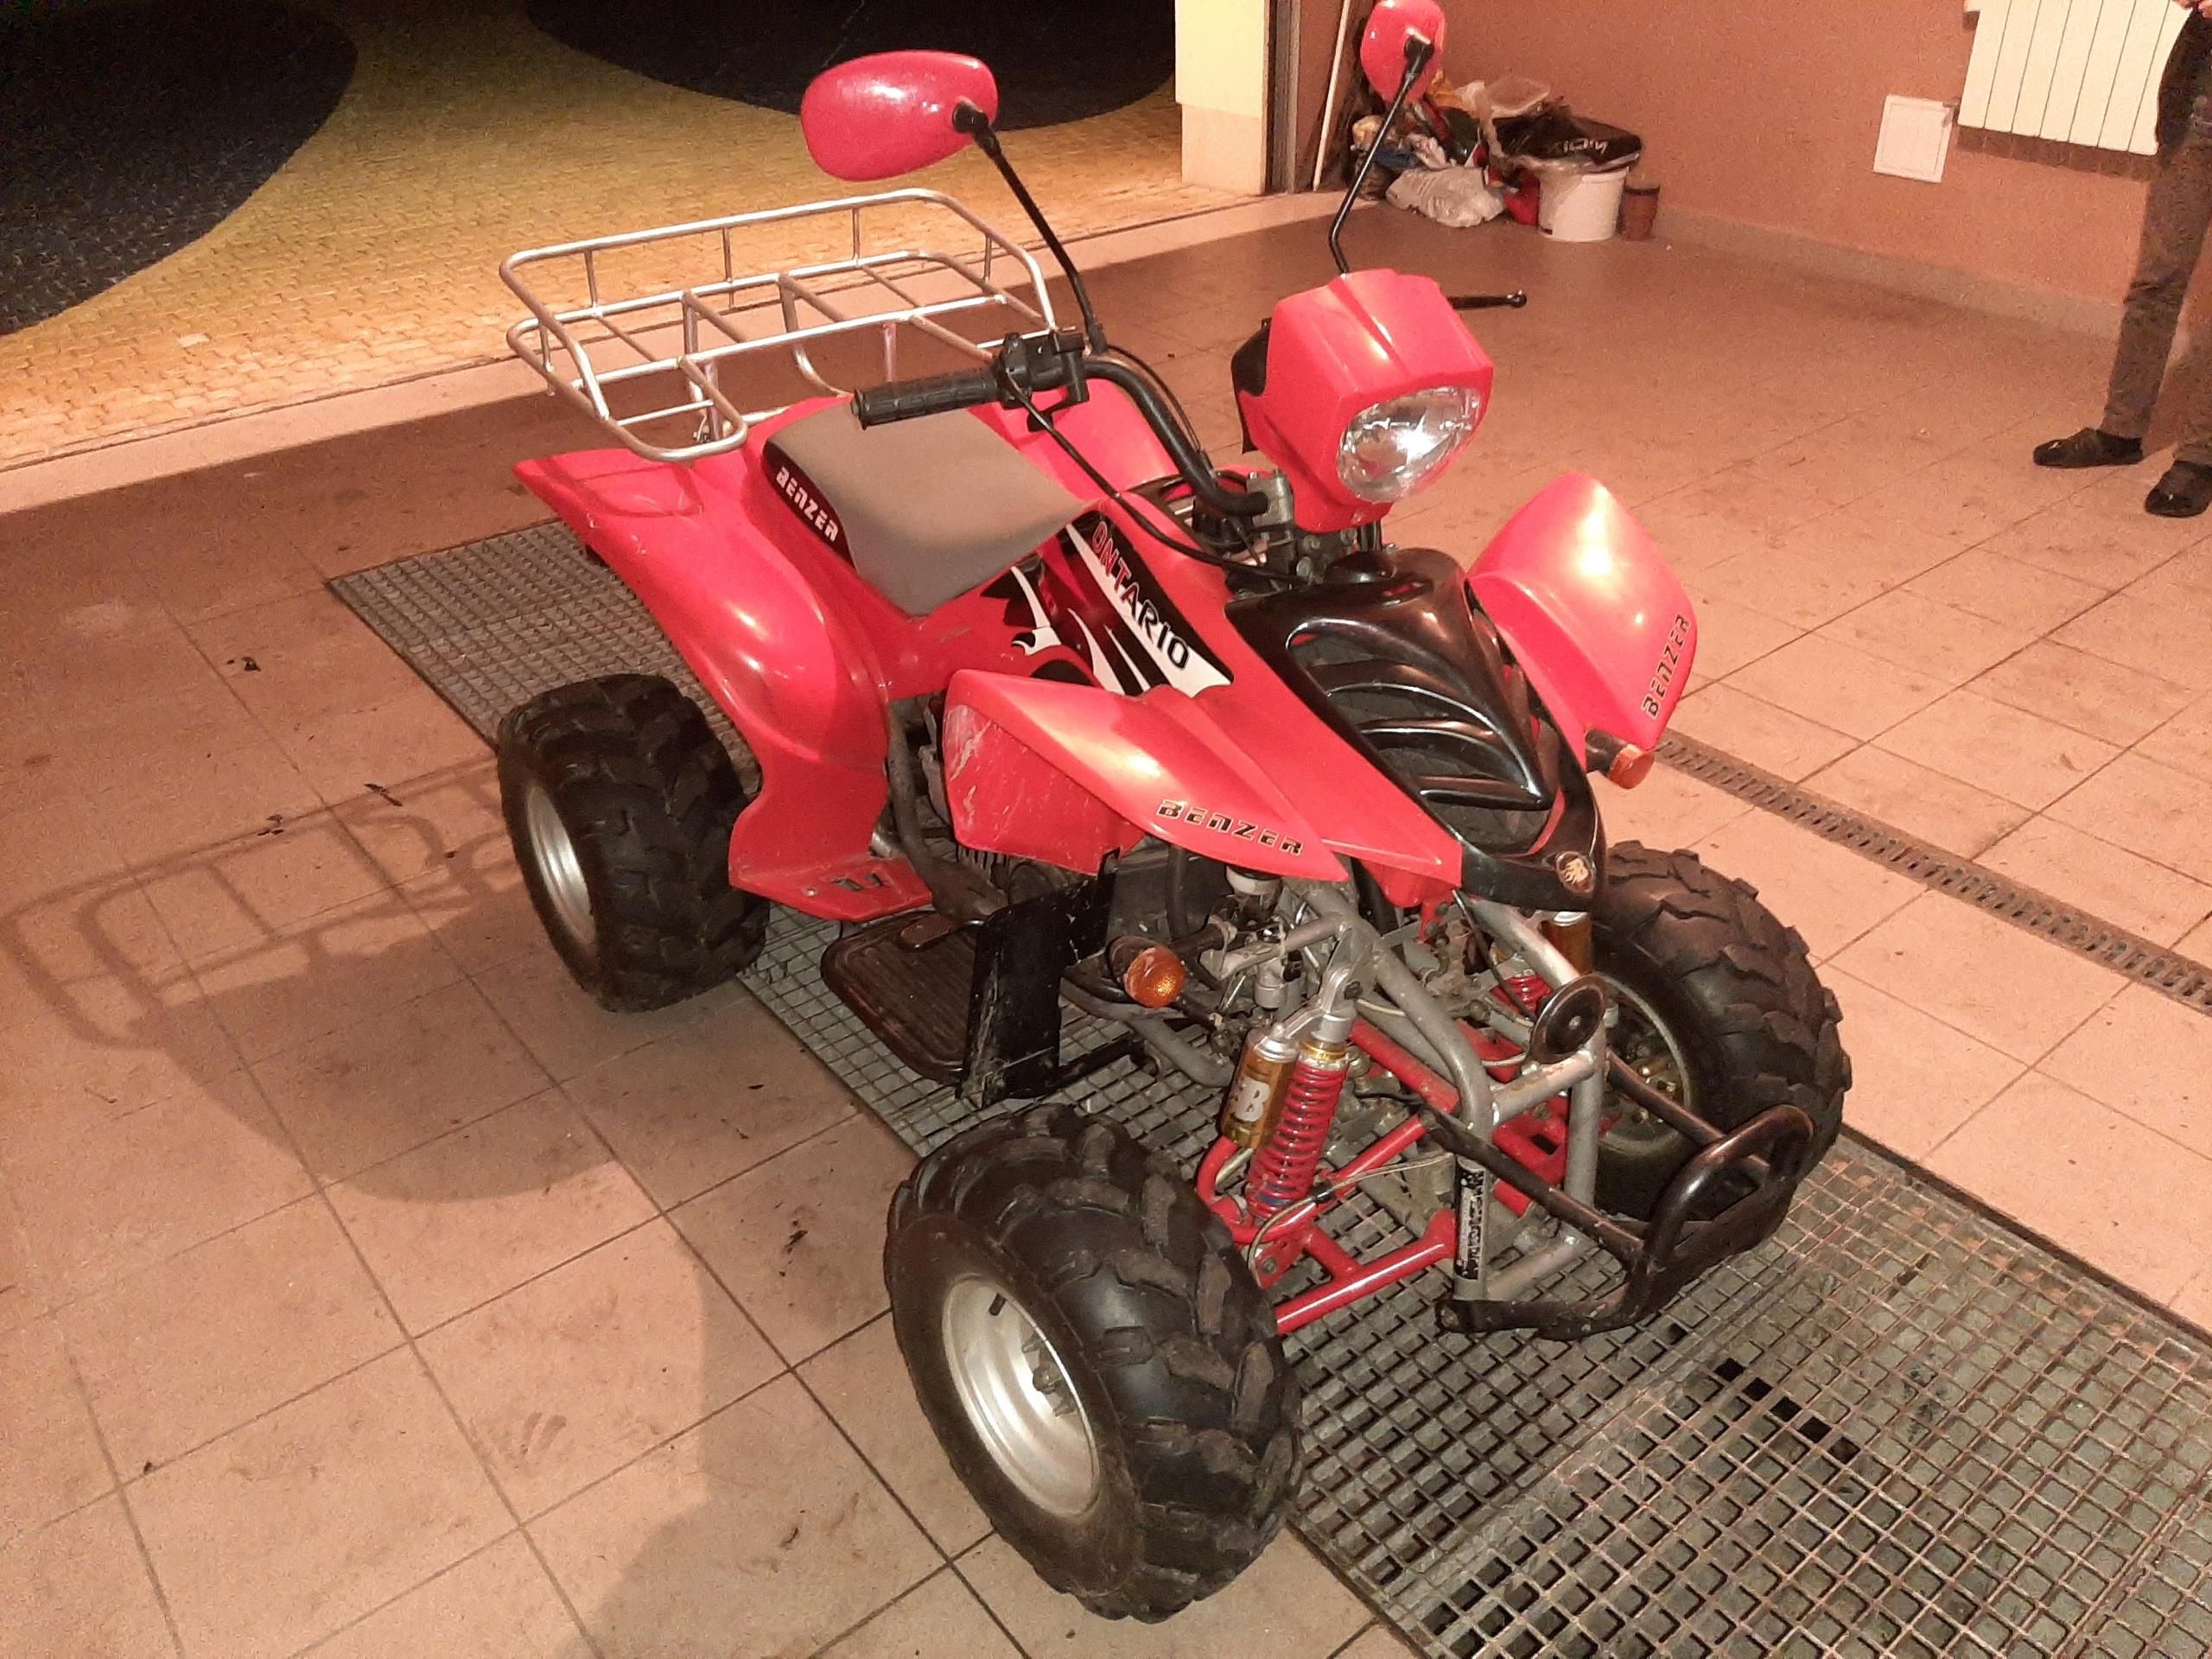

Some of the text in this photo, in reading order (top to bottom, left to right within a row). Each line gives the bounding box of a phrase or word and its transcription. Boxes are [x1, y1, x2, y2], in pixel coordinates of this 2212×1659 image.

[776, 465, 838, 542] BENZER
[1092, 521, 1189, 671] ONTARIO
[1640, 613, 1692, 719] BENZER
[1156, 798, 1304, 857] BENZER
